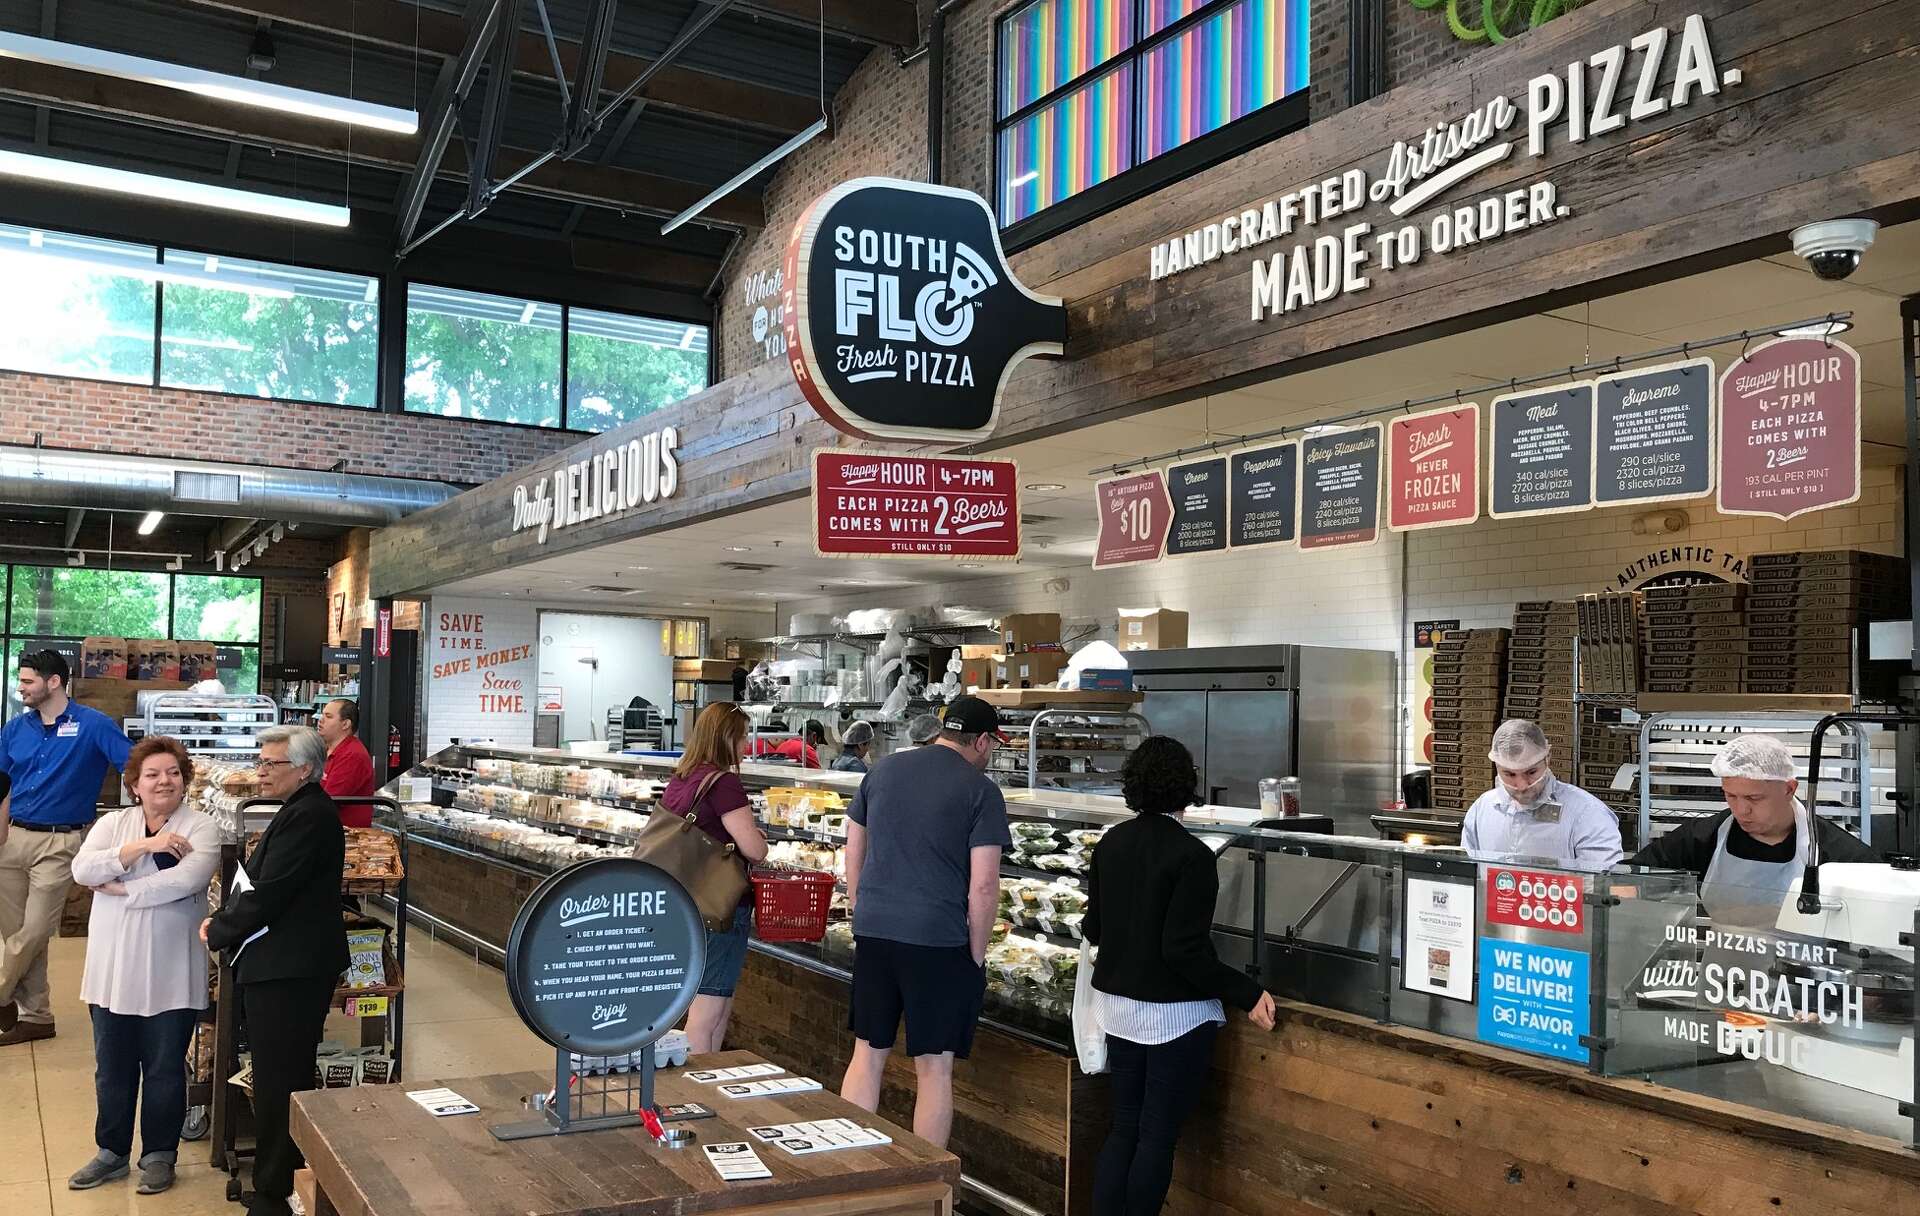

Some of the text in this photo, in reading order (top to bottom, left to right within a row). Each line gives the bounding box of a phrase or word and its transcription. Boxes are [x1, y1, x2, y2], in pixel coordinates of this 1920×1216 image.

[1150, 14, 1742, 281] HANDCRAFTED Artisan PIZZA.
[835, 225, 947, 274] SOUTH
[1251, 180, 1571, 321] MADE TO ORDER.
[835, 268, 975, 346] FLO
[754, 318, 767, 329] FOR
[836, 344, 975, 387] Fresh PIZZA
[1735, 356, 1841, 392] Happy HOUR
[1622, 384, 1681, 410] Supreme
[1759, 391, 1816, 412] 4-7PM
[1526, 402, 1559, 422] Meat
[1751, 410, 1824, 431] EACH PIZZA
[1409, 423, 1451, 454] Fresh
[1748, 426, 1827, 446] COMES WITH
[1243, 455, 1283, 474] Pepperoni
[1306, 447, 1333, 466] Spicy
[1416, 458, 1449, 474] NEVER
[1621, 452, 1681, 468] 290 cal/slice
[1766, 445, 1809, 469] 2 Beers
[841, 462, 926, 486] Happy HOUR
[940, 467, 994, 487] 4-7PM
[1516, 468, 1569, 482] 340 cal/slice
[1616, 464, 1686, 480] 2320 cal/pizza
[1744, 468, 1830, 486] 193 CAL PER PINT
[513, 426, 678, 544] Daily DELICIOUS
[1405, 472, 1461, 500] FROZEN
[1512, 479, 1573, 493] 2720 cal/pizza
[1619, 476, 1682, 491] 8 slices/pizza
[1755, 485, 1817, 498] STILL ONLY $10
[838, 496, 929, 513] EACH PIZZA
[1332, 496, 1360, 507] cal/slice
[1408, 498, 1457, 513] PIZZA SAUCE
[1514, 490, 1570, 504] 8 slices/pizza
[933, 495, 1008, 535] 2 Beers
[1120, 497, 1151, 542] $10
[1317, 515, 1360, 528] 8 slices/pizza
[1333, 507, 1363, 518] cal/pizza
[829, 516, 929, 533] COMES WITH
[891, 542, 952, 551] STILL ONLY $10
[1617, 547, 1714, 587] AUTHENTIC
[440, 613, 484, 633] SAVE
[440, 637, 487, 650] TIME.
[433, 644, 533, 679] SAVE MONEY.
[482, 671, 523, 690] Save
[479, 695, 527, 713] TIME.
[560, 891, 666, 919] Order HERE
[583, 930, 595, 938] GET
[604, 928, 624, 936] ORDER
[574, 945, 594, 954] CHECK
[595, 944, 606, 952] OFF
[607, 943, 625, 951] WHAT
[626, 942, 637, 950] YOU
[638, 941, 656, 949] WANT.
[1665, 925, 1838, 965] OUR PIZZAS START
[351, 952, 379, 964] SKINNY
[585, 959, 606, 967] TICKET
[629, 956, 648, 964] ORDER
[649, 954, 677, 962] COUNTER.
[1494, 949, 1573, 979] WE NOW
[351, 961, 382, 976] POP
[542, 977, 560, 986] WHEN
[574, 975, 589, 983] HEAR
[590, 974, 606, 982] YOUR
[626, 971, 641, 979] YOUR
[641, 970, 657, 978] PIZZA
[665, 967, 685, 976] READY.
[542, 993, 557, 1001] PICK
[620, 985, 653, 994] FRONT-END
[1493, 972, 1574, 1003] DELIVER!
[1643, 960, 1864, 1030] with SCRATCH
[591, 1003, 628, 1022] Enjoy
[1522, 999, 1542, 1010] WITH
[1520, 1011, 1574, 1037] FAVOR
[1664, 1017, 1710, 1045] MADE
